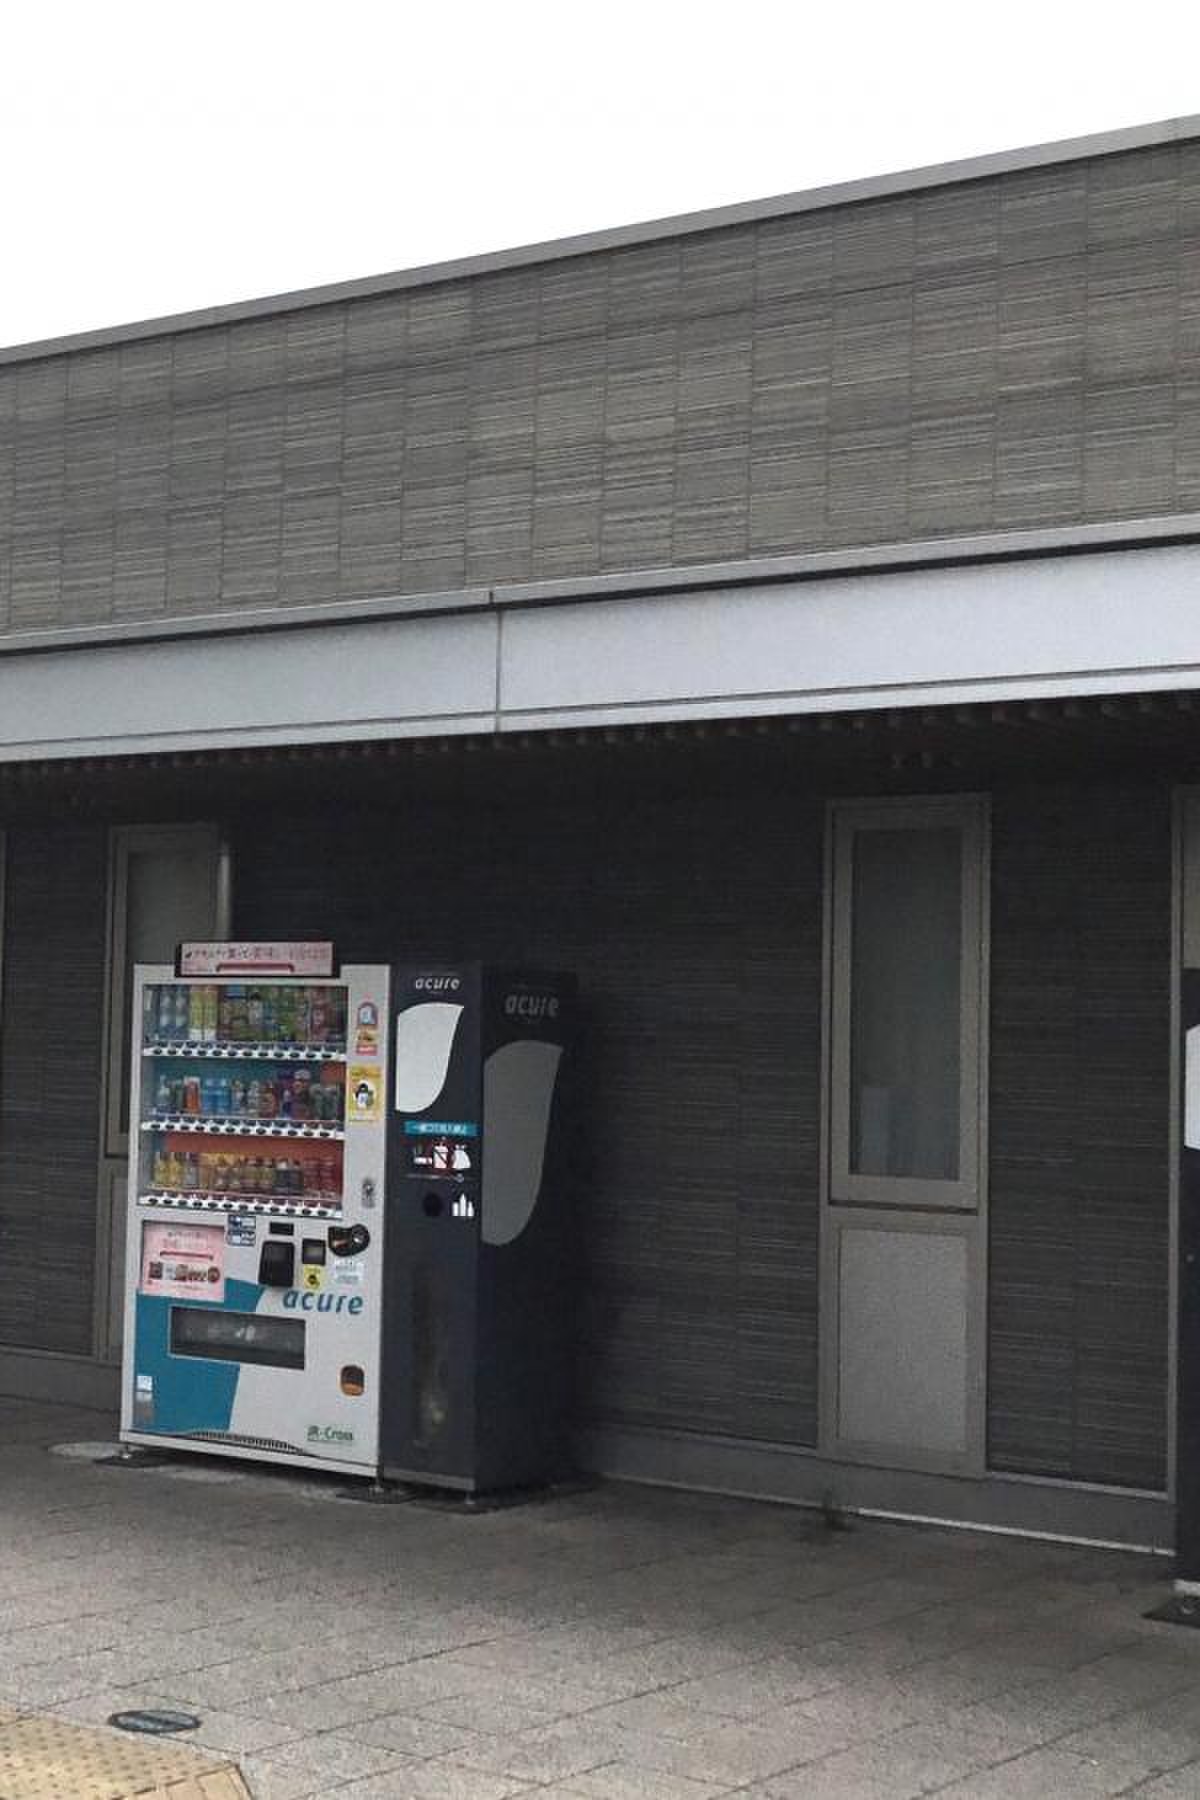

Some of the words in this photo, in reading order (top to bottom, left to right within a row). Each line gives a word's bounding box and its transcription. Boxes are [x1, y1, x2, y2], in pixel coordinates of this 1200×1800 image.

[415, 975, 461, 990] acure
[504, 994, 560, 1018] acure
[282, 1289, 364, 1315] acure
